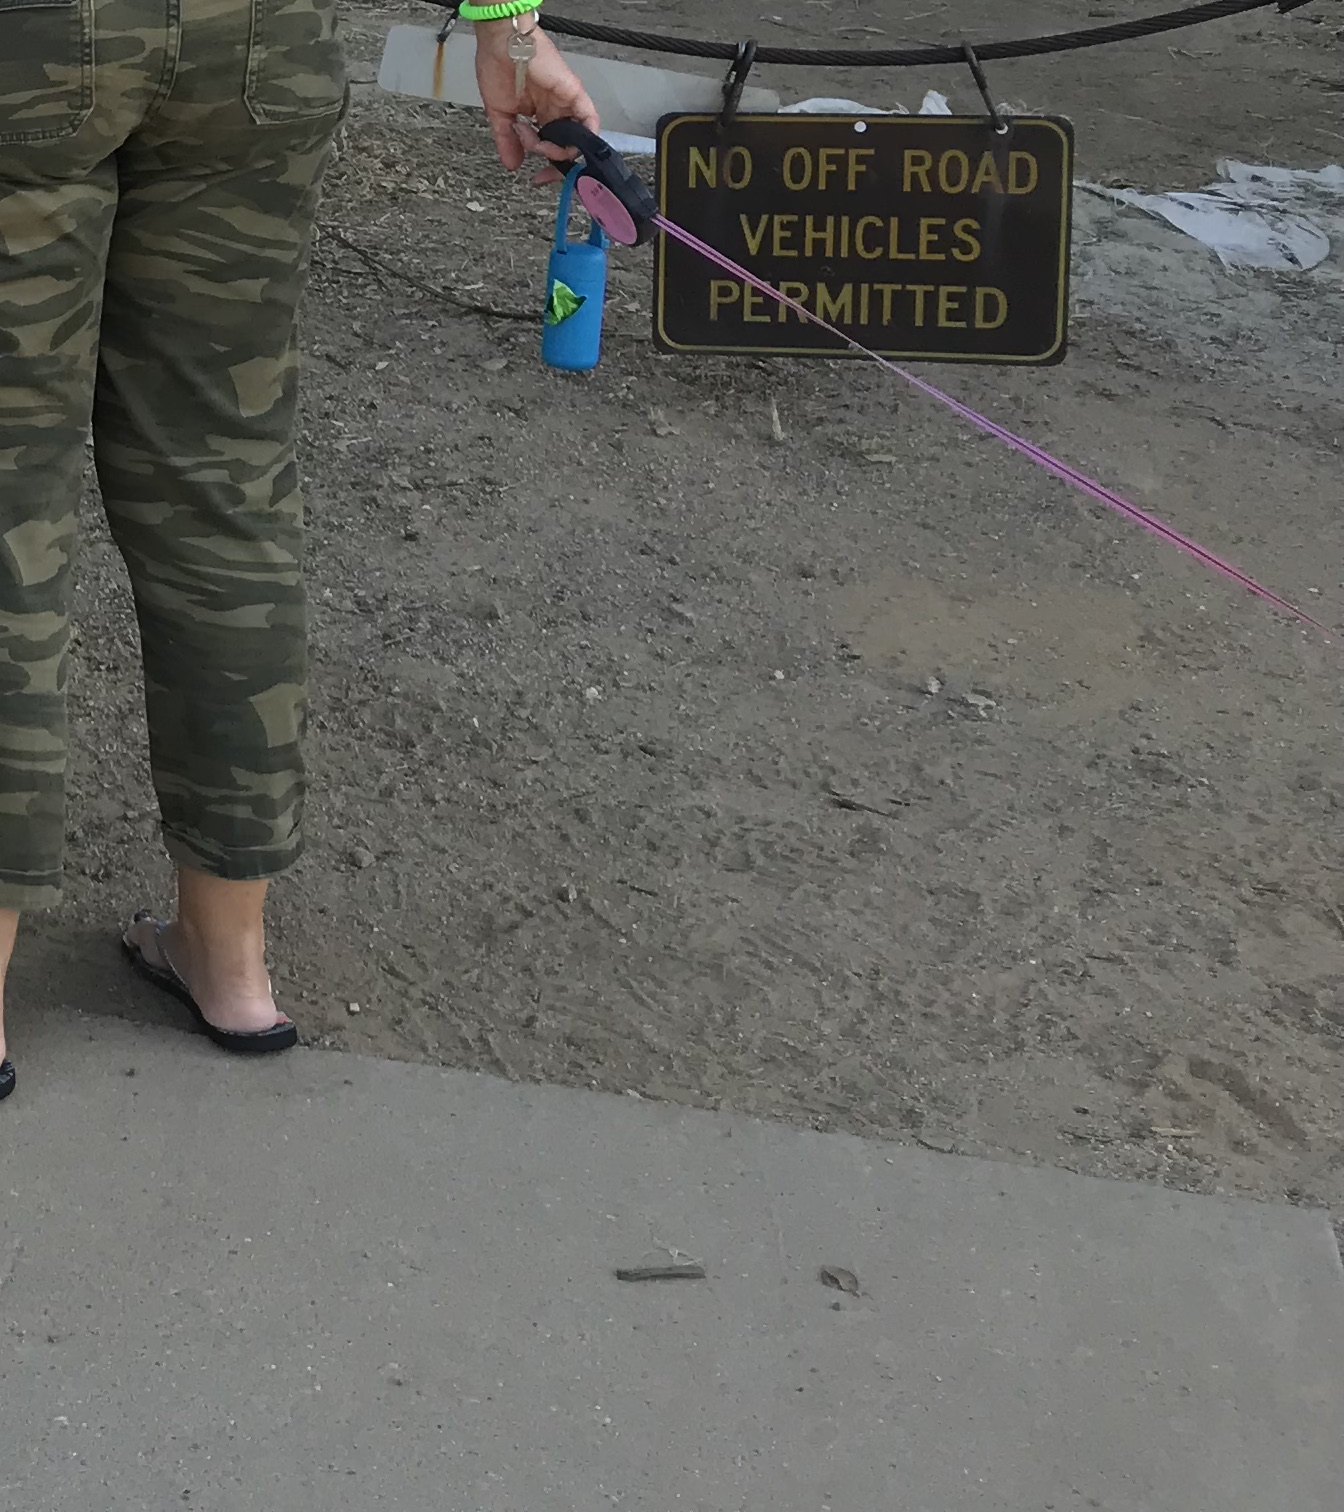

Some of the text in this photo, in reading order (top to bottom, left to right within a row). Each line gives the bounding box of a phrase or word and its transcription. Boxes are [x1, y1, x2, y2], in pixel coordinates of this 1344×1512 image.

[688, 146, 1039, 195] NO OFF ROAD
[739, 213, 982, 262] VEHICLES
[709, 279, 1009, 329] PERMITTED
